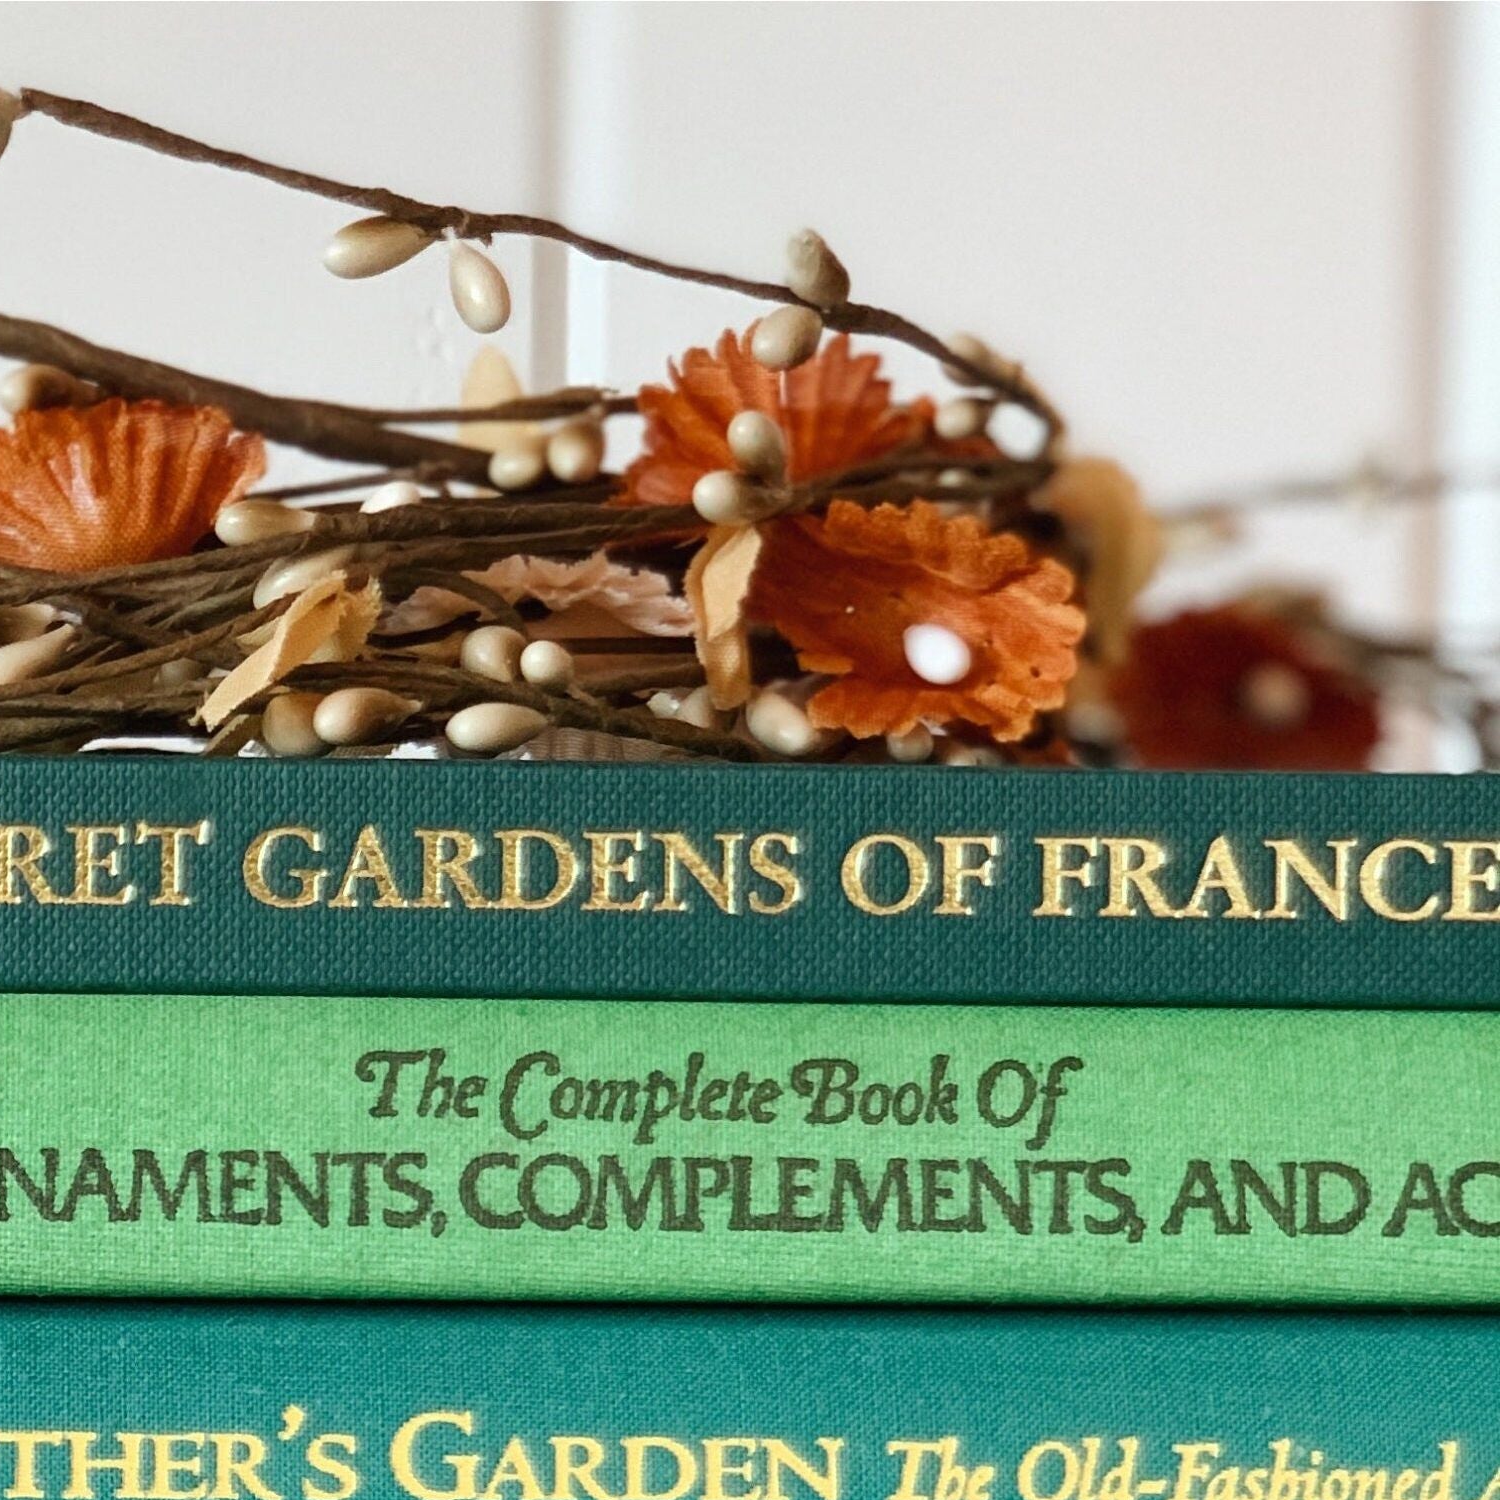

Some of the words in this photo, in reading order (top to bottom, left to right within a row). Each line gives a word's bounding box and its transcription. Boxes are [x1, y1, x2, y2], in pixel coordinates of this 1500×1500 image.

[243, 827, 806, 915] GARDENS
[842, 834, 1005, 915] OF
[1035, 838, 1500, 921] FRANCE
[354, 1048, 484, 1119] The
[501, 1052, 779, 1145] Complete
[789, 1055, 959, 1125] Book
[977, 1056, 1086, 1150] Of
[461, 1153, 1145, 1242] COMPLEMENTS,
[1162, 1162, 1372, 1238] AND
